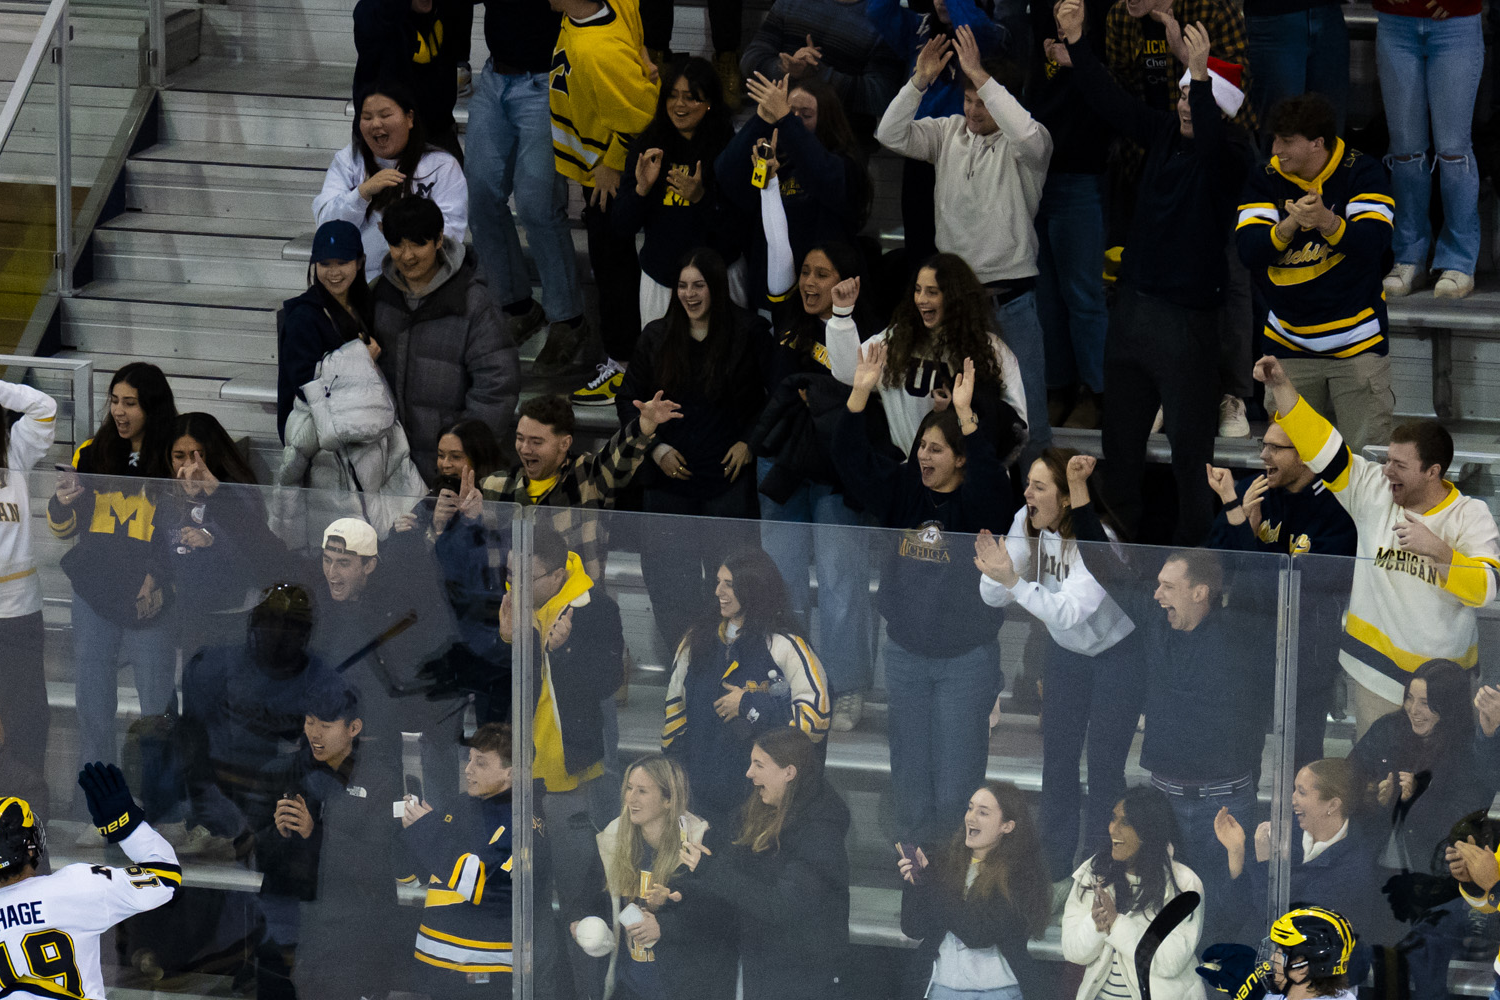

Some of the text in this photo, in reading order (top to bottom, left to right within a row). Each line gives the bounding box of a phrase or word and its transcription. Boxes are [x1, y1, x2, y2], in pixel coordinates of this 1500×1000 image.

[1144, 40, 1167, 54] ICH
[89, 490, 156, 541] M
[1374, 547, 1437, 586] MCHIGAN
